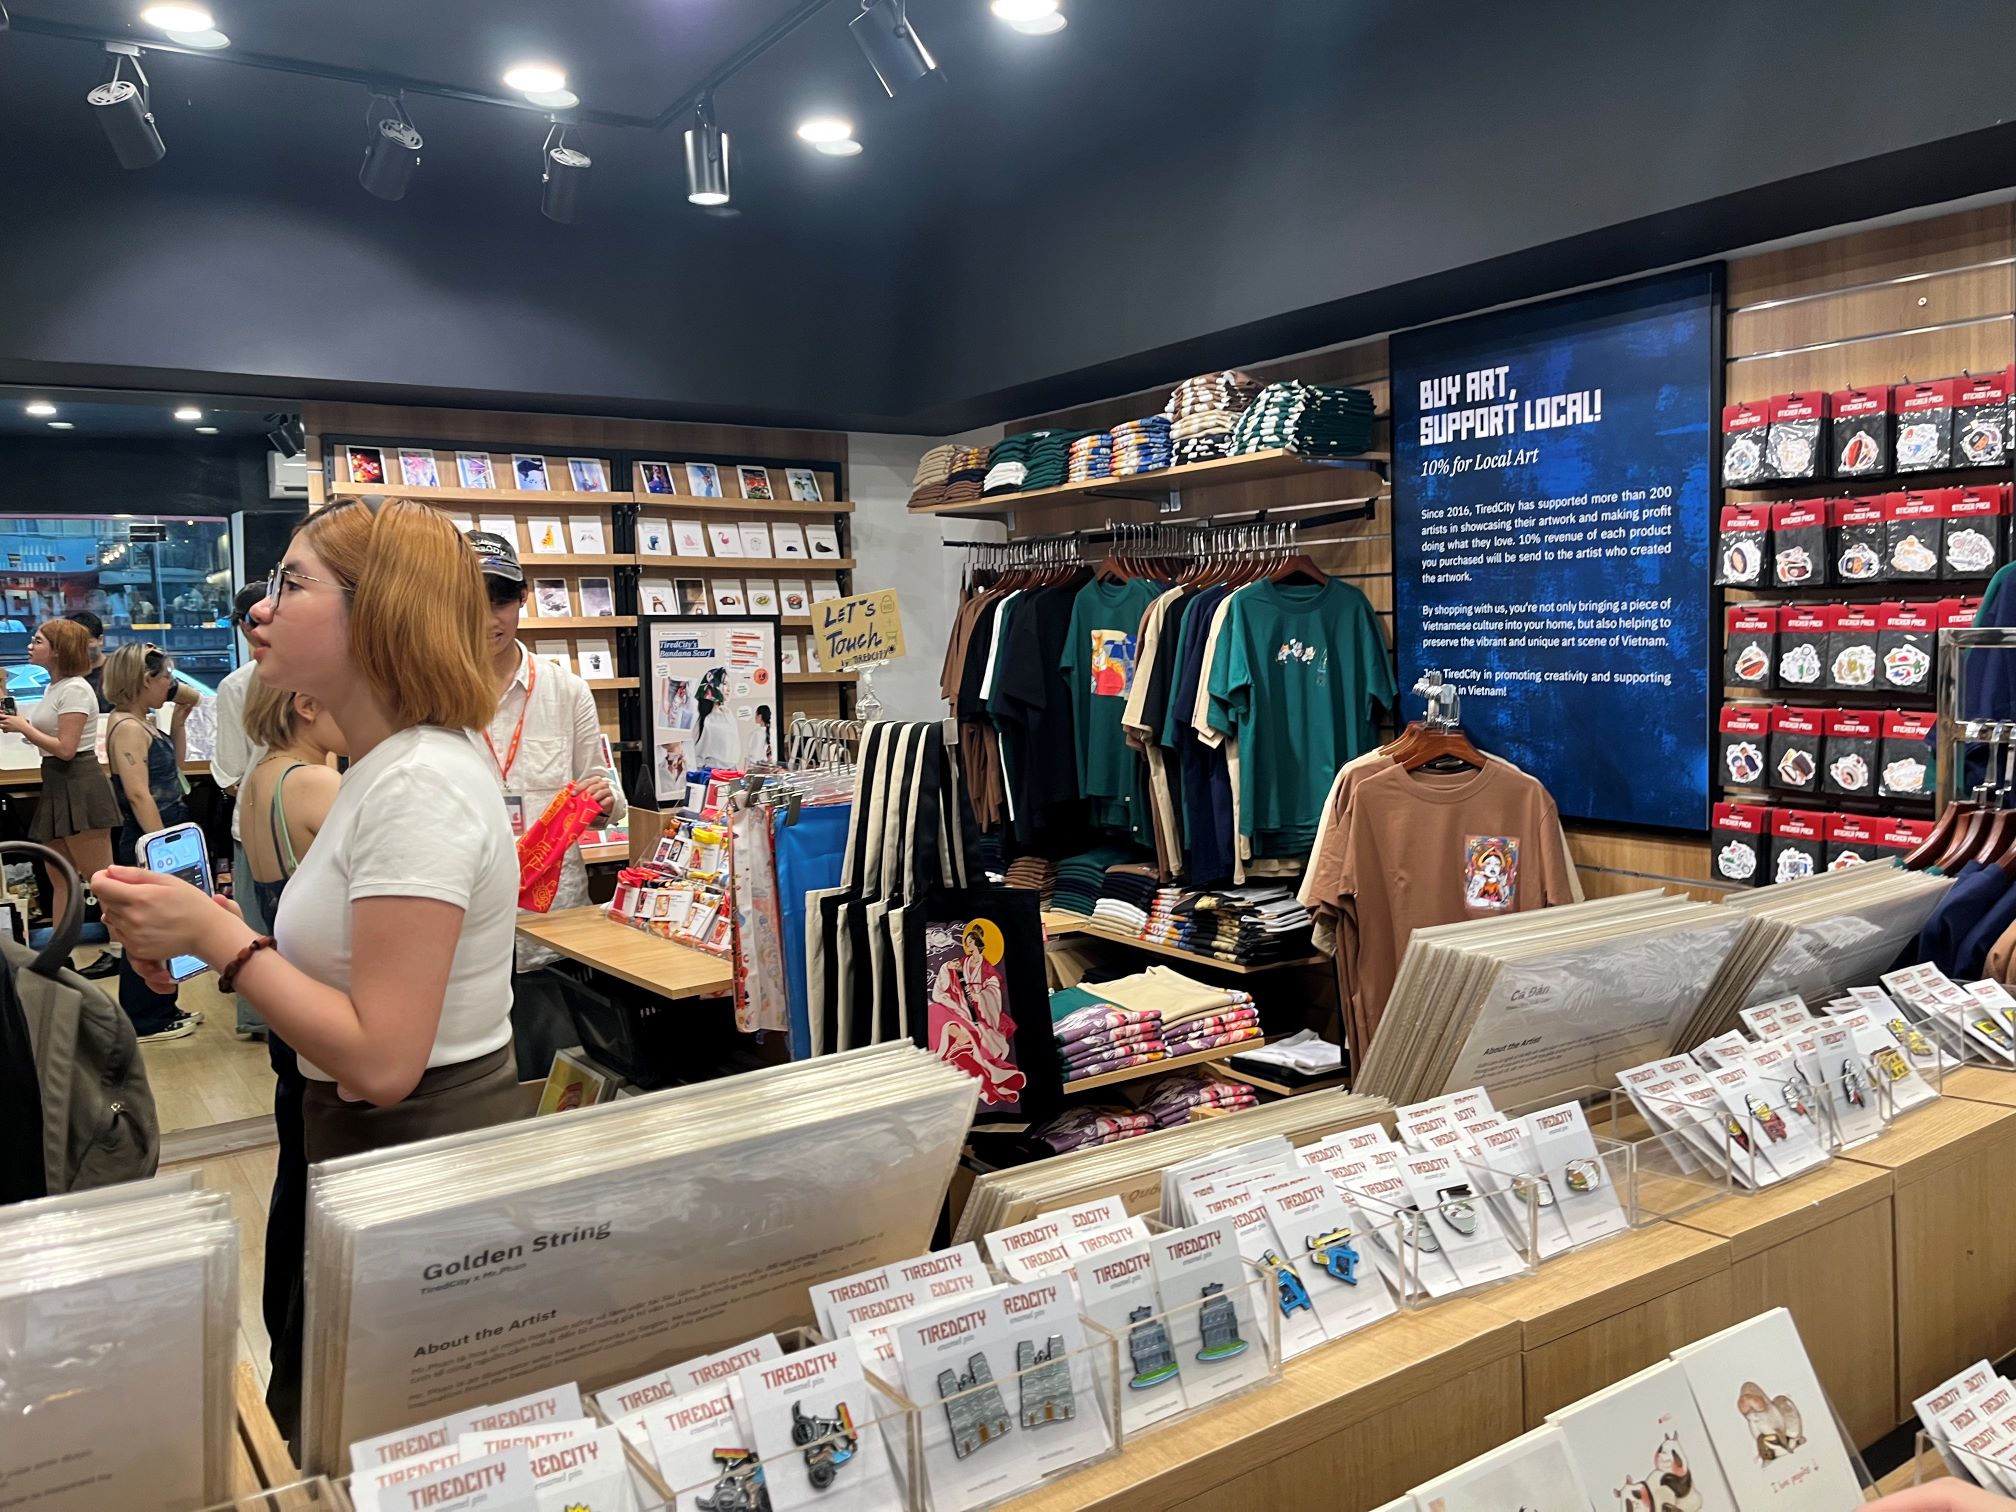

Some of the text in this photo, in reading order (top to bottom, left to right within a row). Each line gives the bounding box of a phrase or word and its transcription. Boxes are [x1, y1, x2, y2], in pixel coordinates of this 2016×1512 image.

[1420, 365, 1517, 410] BUY ART,
[1420, 388, 1601, 446] SUPPORT LOCAL!
[1420, 448, 1539, 477] 10% for Local Art
[1421, 486, 1672, 519] Since 2016, TiredCity has supported more than 200
[1421, 505, 1672, 536] artists in showcasing their artwork and making profit
[1421, 524, 1672, 552] doing what they love. 10% revenue of each product
[1421, 542, 1672, 570] you purchased will be send to the artist who created
[1422, 571, 1473, 584] the artwork.
[1422, 597, 1672, 617] By shopping with us, you're not only bringing a piece of
[1422, 617, 1672, 632] Vietnamese culture into your home, but also helping to
[826, 622, 882, 658] Touch
[1422, 635, 1669, 649] preserve the vibrant and unique art scene of Vietnam.
[1423, 668, 1672, 686] Join TiredCity in promoting creativity and supporting
[1458, 685, 1507, 697] in Vietnam!
[1536, 1109, 1573, 1130] TIREDCITY
[1349, 1133, 1377, 1149] EDCITY
[1484, 1127, 1520, 1147] TIREDCITY
[1408, 1158, 1450, 1175] TIREDCITY
[1276, 1185, 1325, 1211] TIREDCITY
[1073, 1207, 1110, 1227] EDCITY
[423, 1219, 613, 1282] Golden String
[1002, 1224, 1058, 1252] TIREDCITY
[1166, 1230, 1222, 1261] TIREDCITY
[900, 1253, 963, 1281] TIREDCITY
[1020, 1244, 1069, 1270] TIREDCIT
[1093, 1252, 1151, 1285] TIREDCITY
[930, 1275, 975, 1298] EDCITY
[1003, 1286, 1057, 1315] REDCITY
[847, 1293, 916, 1323] TIREDCITY
[414, 1310, 557, 1358] About the Artist
[917, 1310, 987, 1346] TIREDCITY
[688, 1347, 761, 1386] TIREDCITY
[761, 1351, 838, 1389] TIREDCITY
[617, 1380, 674, 1412] TIREDC
[469, 1398, 557, 1433] TIREDCITY
[665, 1394, 734, 1431] TIREDCIT
[376, 1427, 448, 1464] TIREDCI
[530, 1441, 599, 1478] REDCITY
[408, 1461, 506, 1511] TIREDCITY
